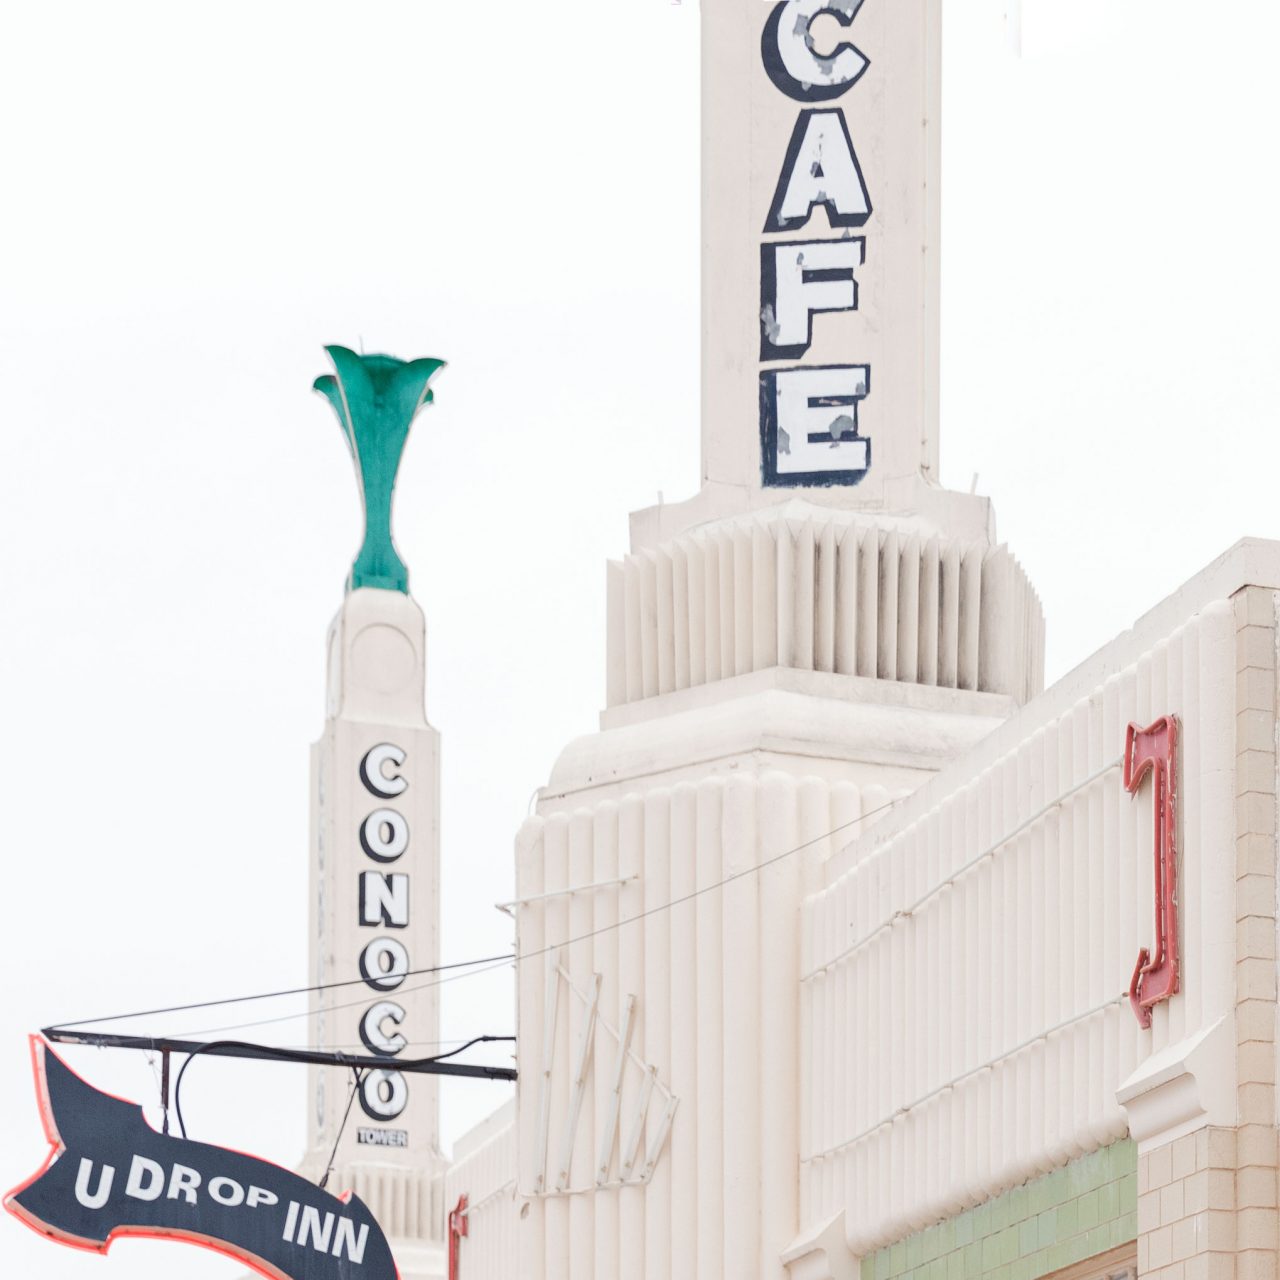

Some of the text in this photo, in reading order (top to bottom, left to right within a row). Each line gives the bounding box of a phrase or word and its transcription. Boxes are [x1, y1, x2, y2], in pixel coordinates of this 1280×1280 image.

[759, 0, 873, 488] CAFE
[358, 742, 409, 1122] CONOCO
[74, 1154, 370, 1265] U DROP INN
[357, 1127, 408, 1148] TOWER
